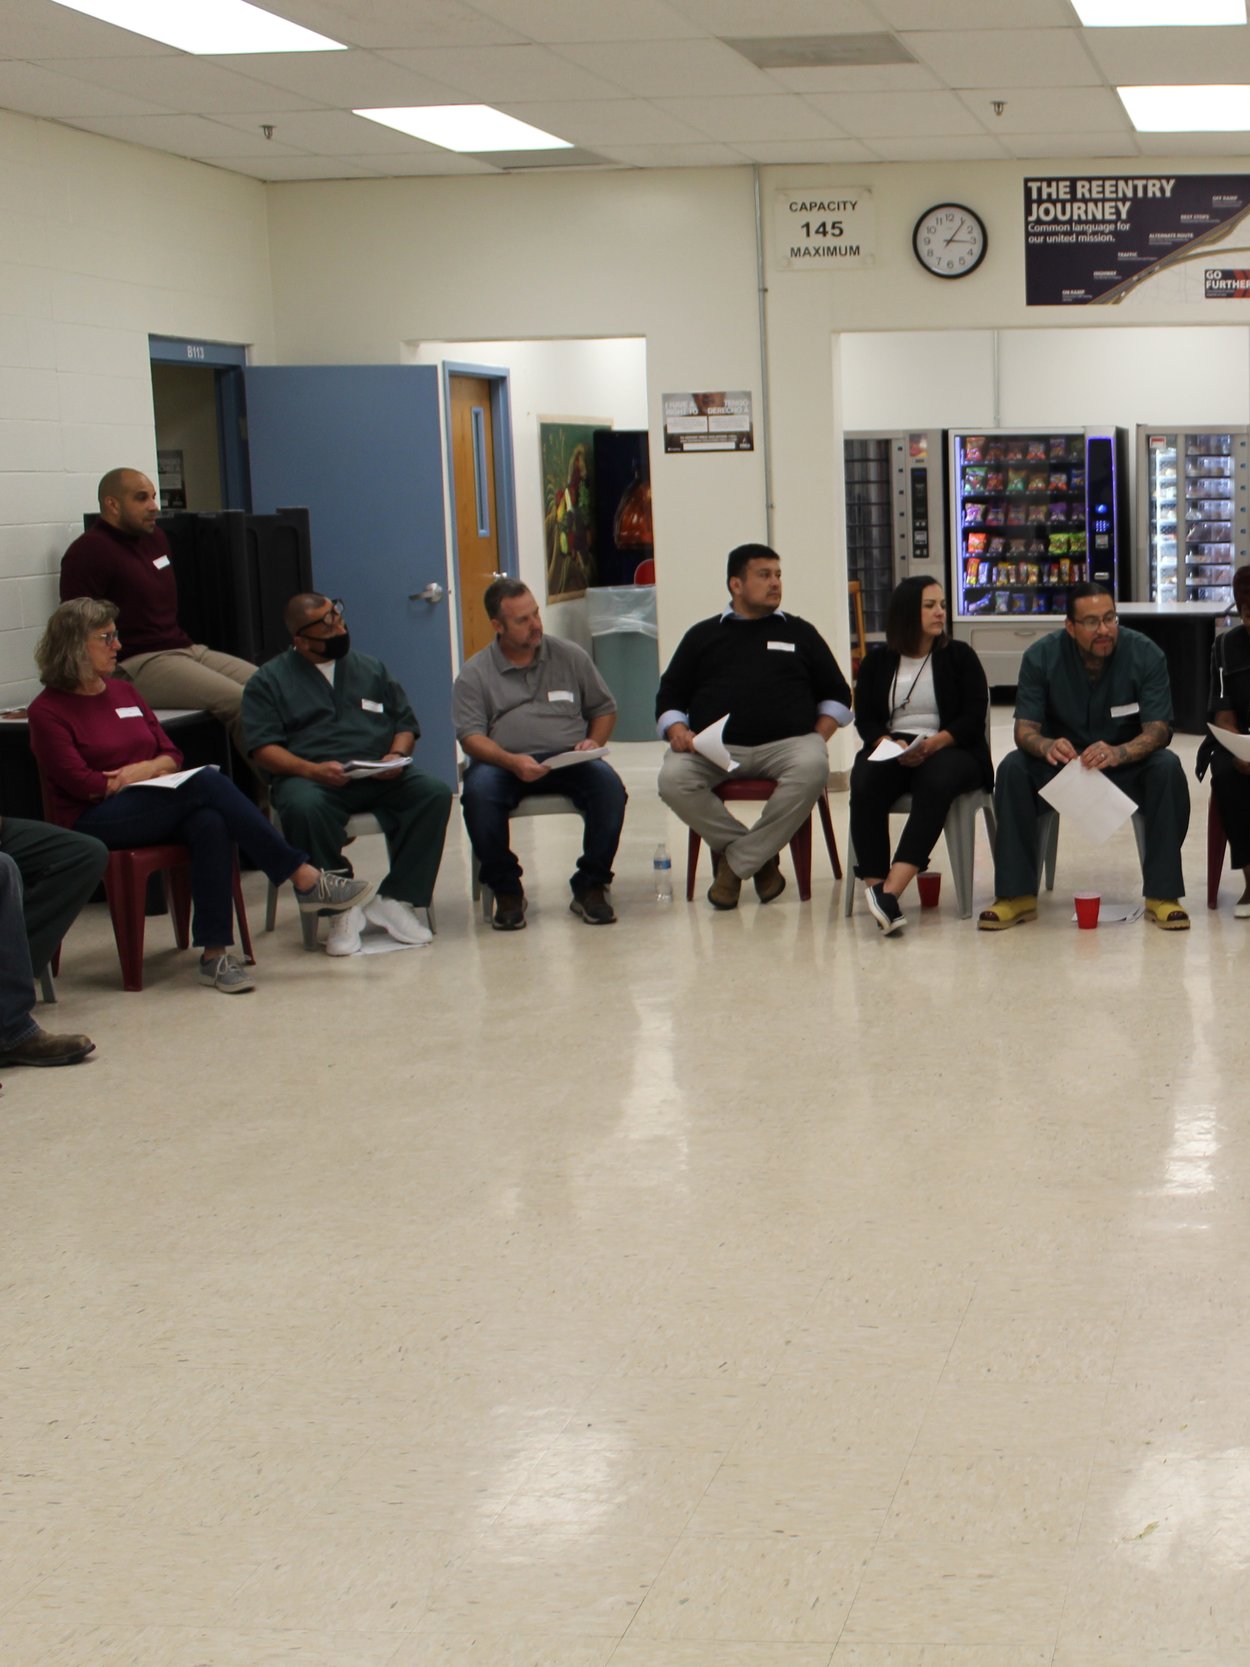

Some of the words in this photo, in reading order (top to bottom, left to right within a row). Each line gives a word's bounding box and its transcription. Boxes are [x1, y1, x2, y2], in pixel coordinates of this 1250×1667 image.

[1027, 180, 1071, 200] THE
[1076, 179, 1175, 199] REENTRY
[789, 200, 858, 212] CAPACITY
[1027, 201, 1131, 222] JOURNEY
[935, 217, 943, 226] 11
[945, 213, 954, 222] 12
[800, 221, 844, 238] 145
[926, 226, 936, 234] 10
[967, 226, 973, 234] 2
[1028, 222, 1070, 232] Common
[1072, 222, 1115, 233] language
[1117, 221, 1130, 231] for
[923, 237, 930, 245] 9
[970, 237, 977, 245] 3
[1028, 235, 1044, 243] our
[1046, 233, 1075, 243] united
[1078, 232, 1116, 242] mission.
[789, 245, 861, 258] MAXIMUM
[927, 249, 933, 257] 8
[936, 258, 942, 266] 7
[947, 261, 953, 269] 6
[1206, 270, 1222, 279] GO
[187, 345, 205, 359] B113
